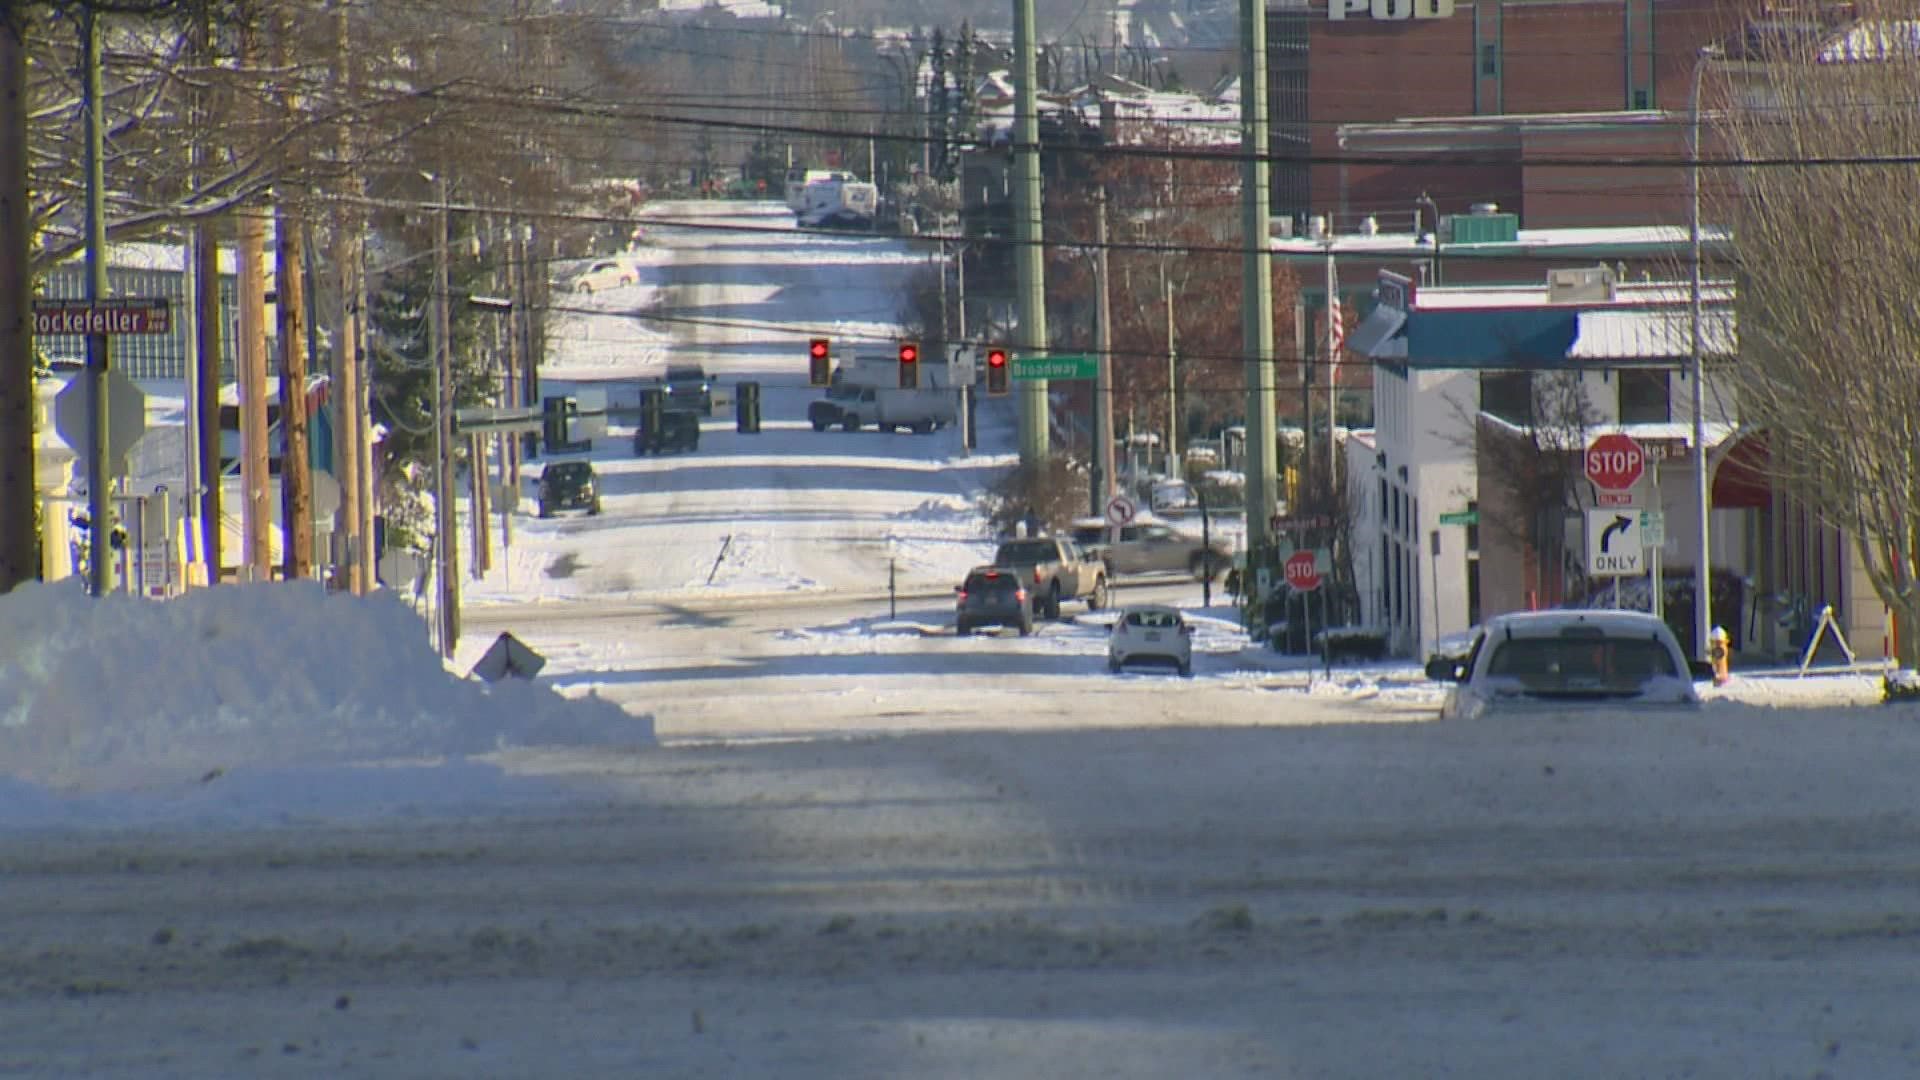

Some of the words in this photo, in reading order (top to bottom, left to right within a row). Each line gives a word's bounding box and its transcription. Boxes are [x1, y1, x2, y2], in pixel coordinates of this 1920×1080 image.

[1013, 361, 1078, 377] Broadway
[1645, 442, 1667, 458] kes
[1589, 450, 1640, 474] STOP
[1287, 562, 1315, 578] STO
[1596, 554, 1637, 570] ONLY
